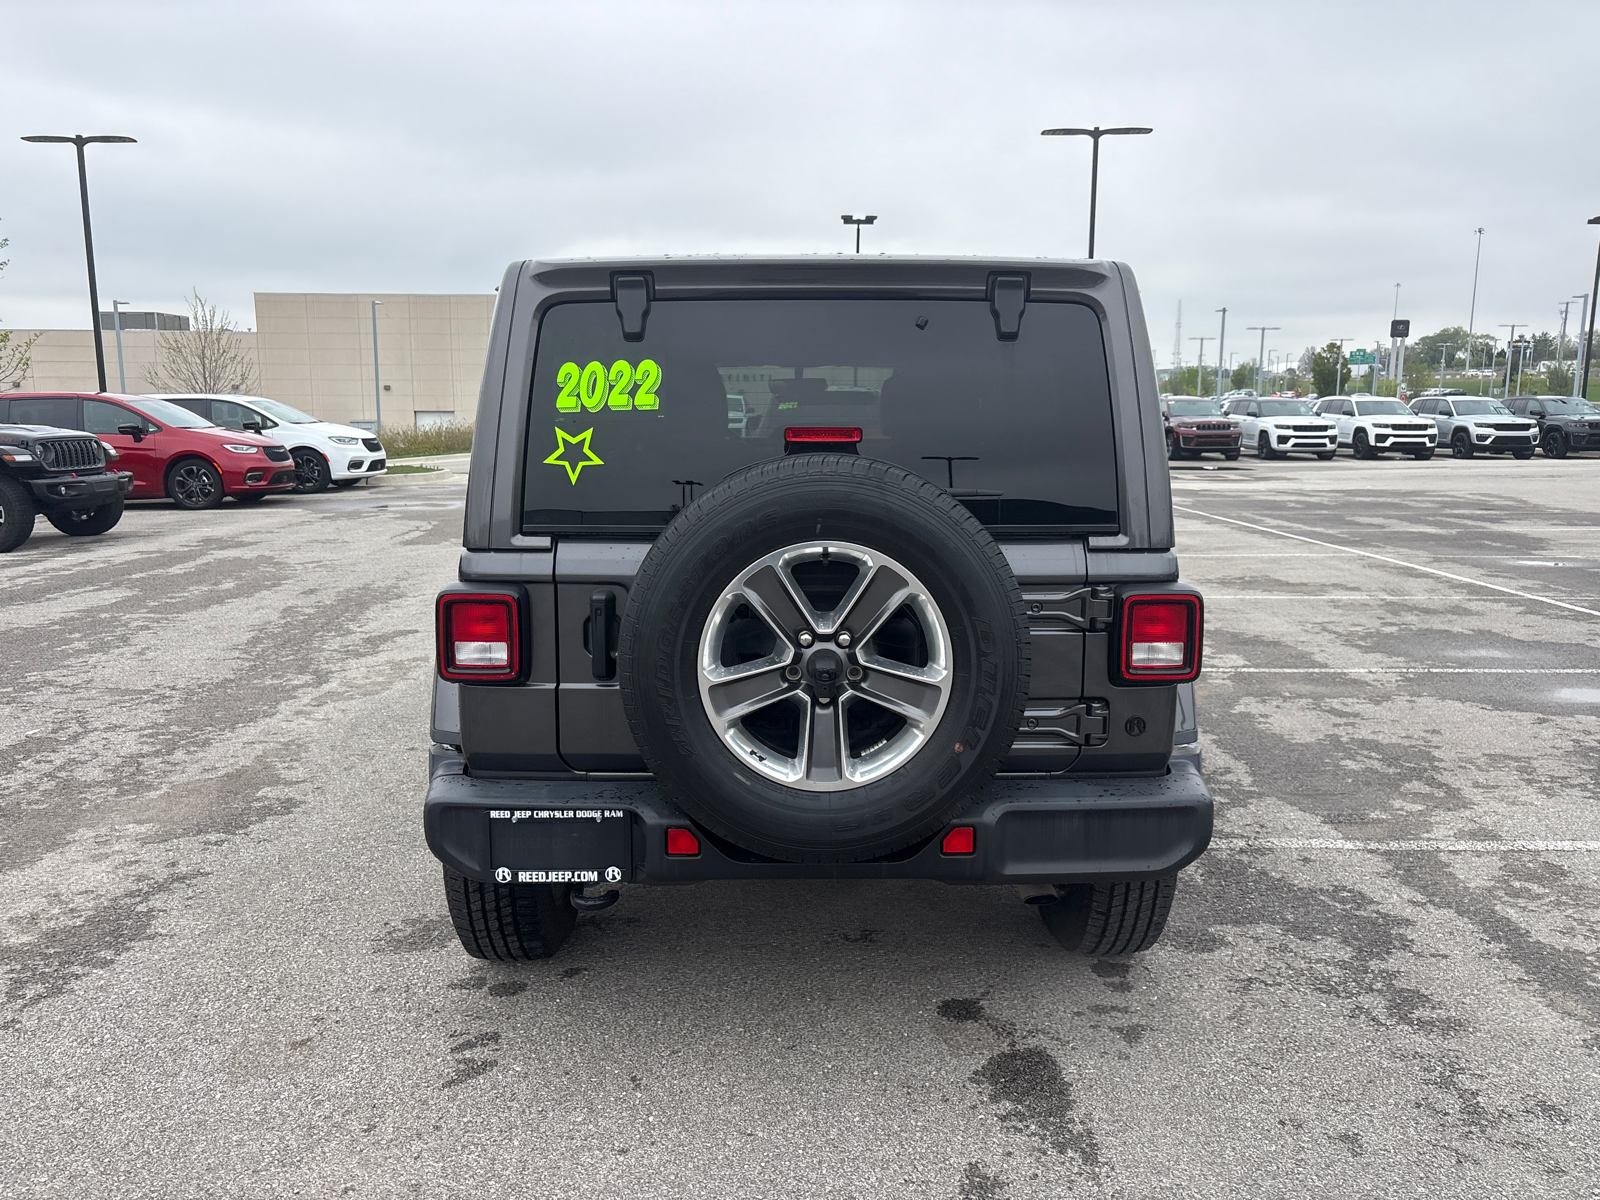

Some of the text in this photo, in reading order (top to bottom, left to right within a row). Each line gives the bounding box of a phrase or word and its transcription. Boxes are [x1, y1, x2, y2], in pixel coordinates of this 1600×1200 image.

[556, 359, 662, 413] 2022
[490, 810, 623, 819] REED JEEP CHRYSLER DODGE RAM
[518, 870, 598, 883] REEDJEEP.COM
